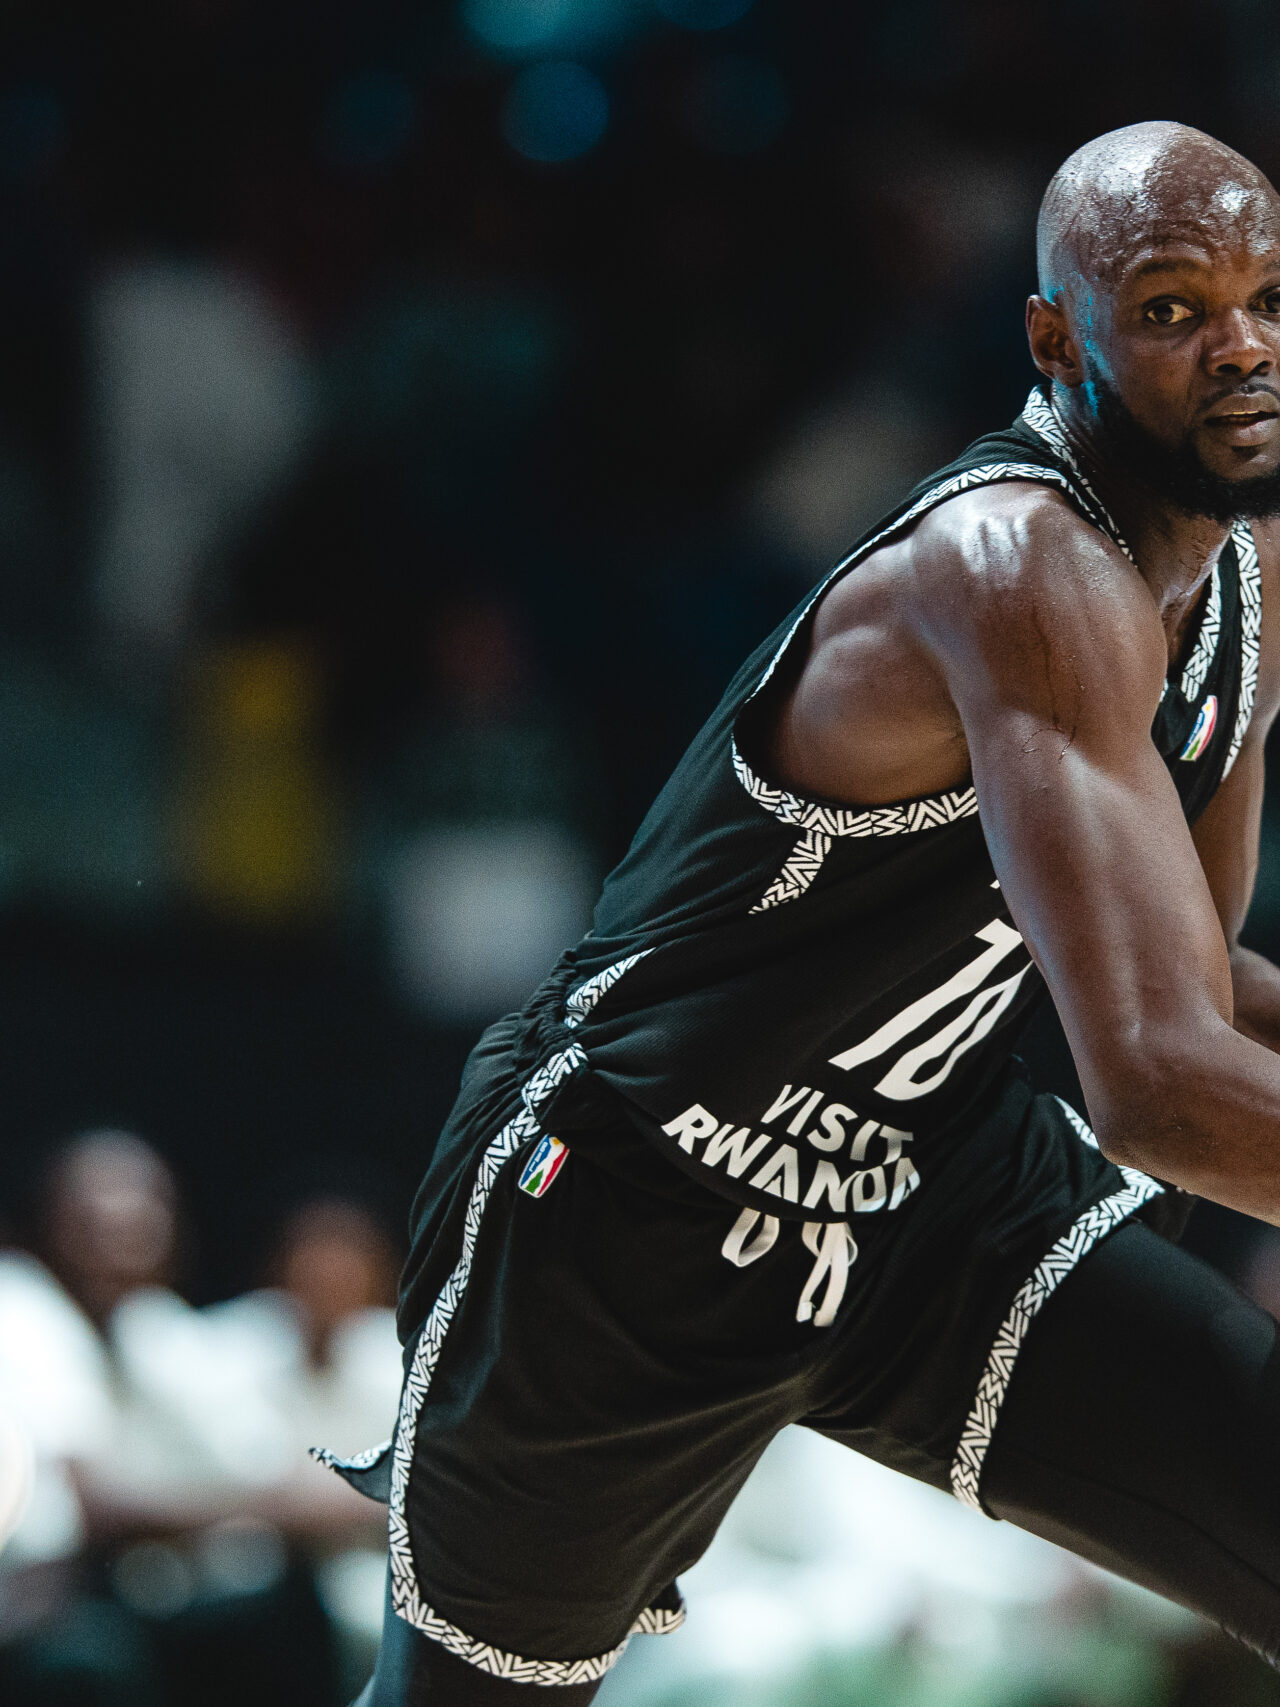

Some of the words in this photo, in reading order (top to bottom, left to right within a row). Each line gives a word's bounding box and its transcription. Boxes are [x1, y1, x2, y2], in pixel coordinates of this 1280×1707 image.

[828, 918, 1034, 1100] 10
[661, 1103, 920, 1212] RWANDA
[760, 1084, 914, 1165] VISIT
